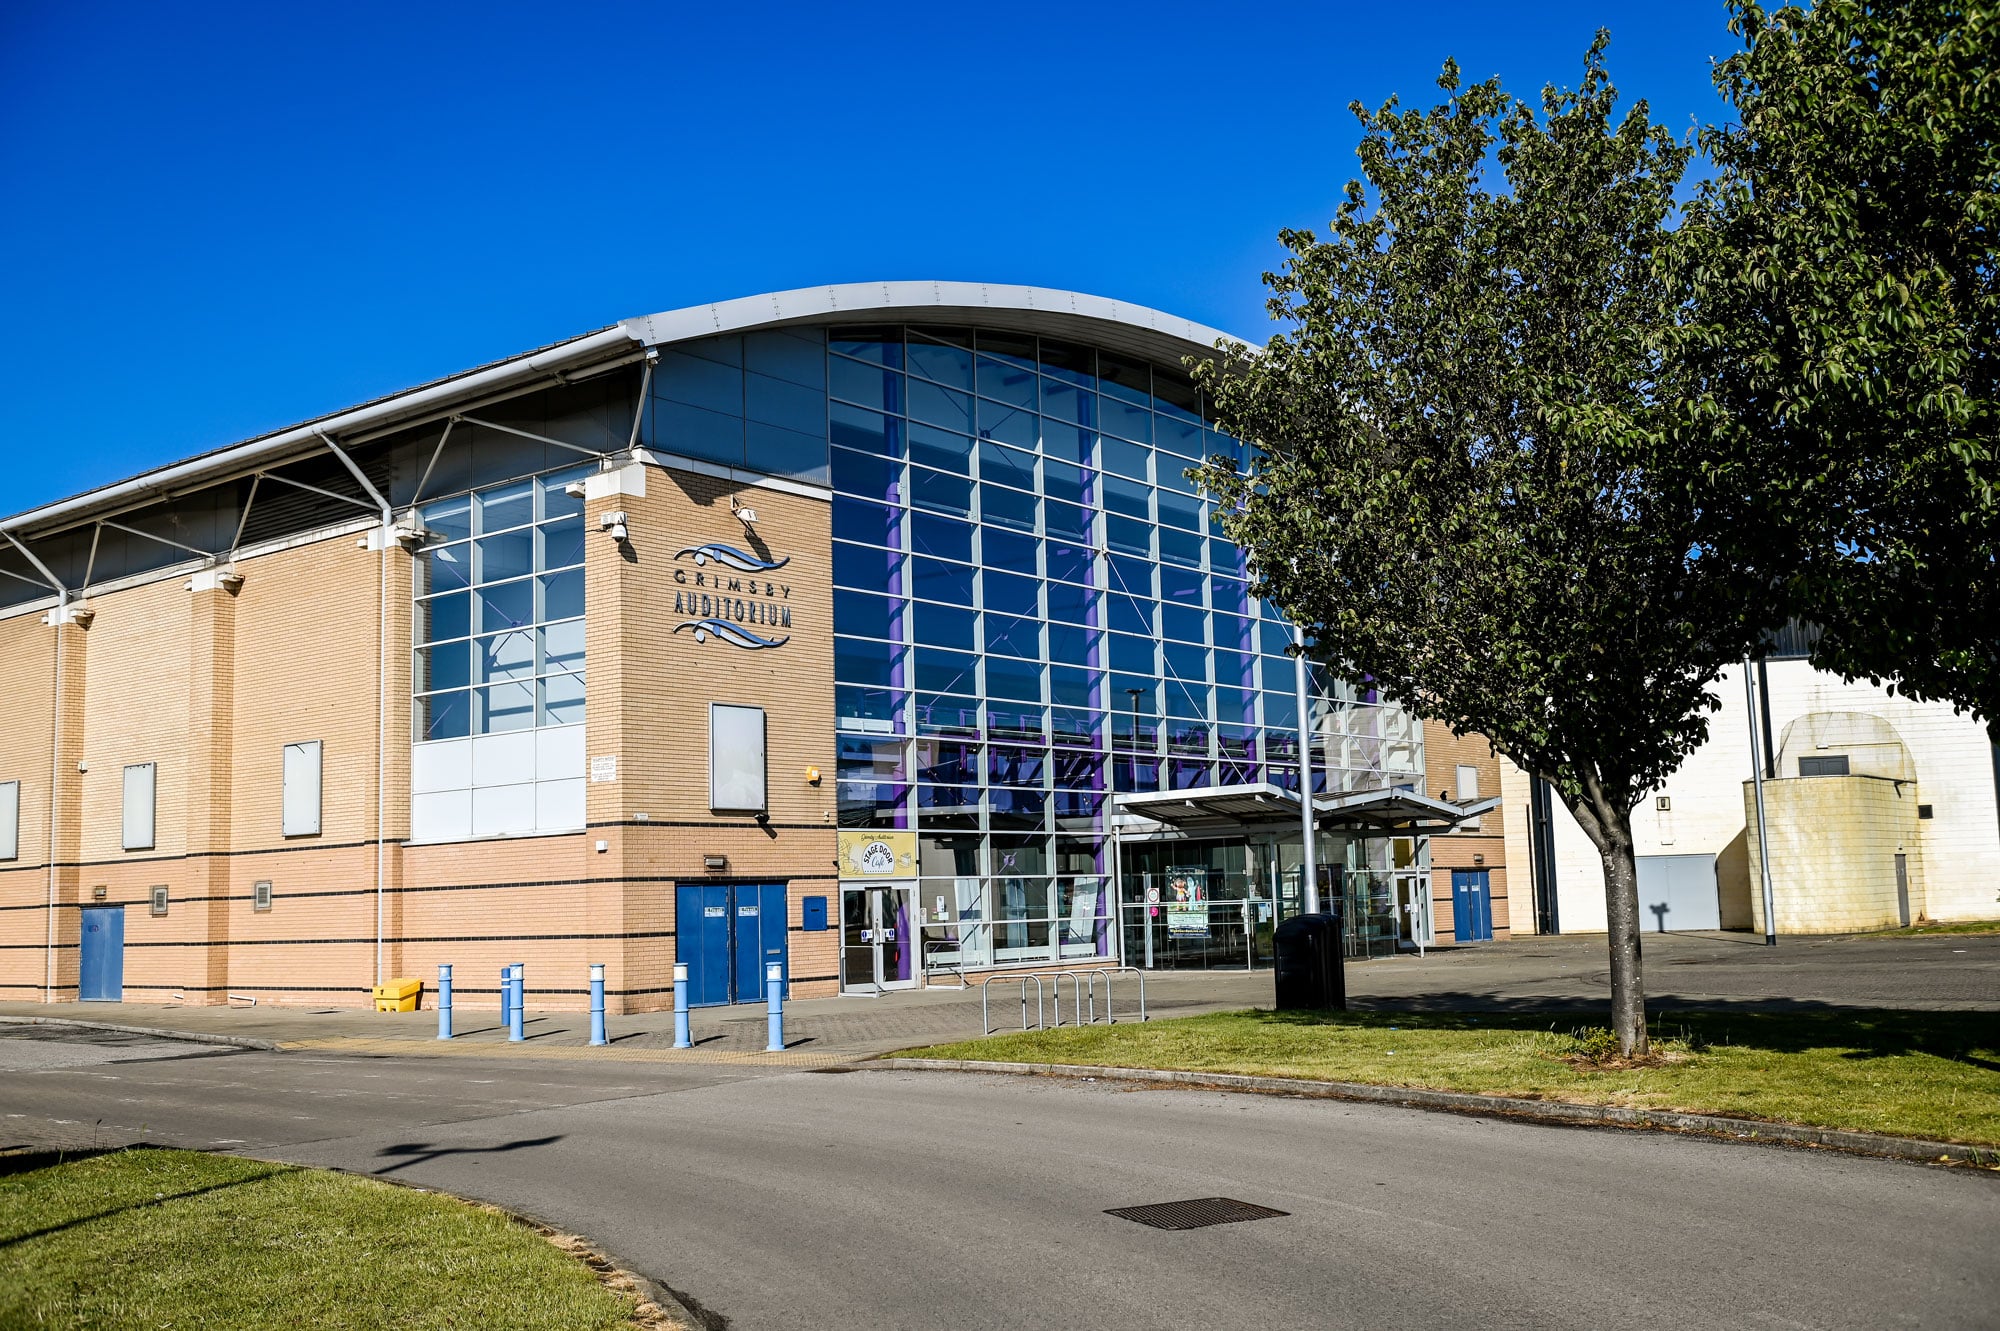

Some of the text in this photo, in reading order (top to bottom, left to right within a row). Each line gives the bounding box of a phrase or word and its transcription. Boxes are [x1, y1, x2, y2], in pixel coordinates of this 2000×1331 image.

[674, 569, 790, 598] GRIMSBY
[674, 590, 791, 628] AUDITORIUM
[863, 845, 893, 864] STAGE DOOR
